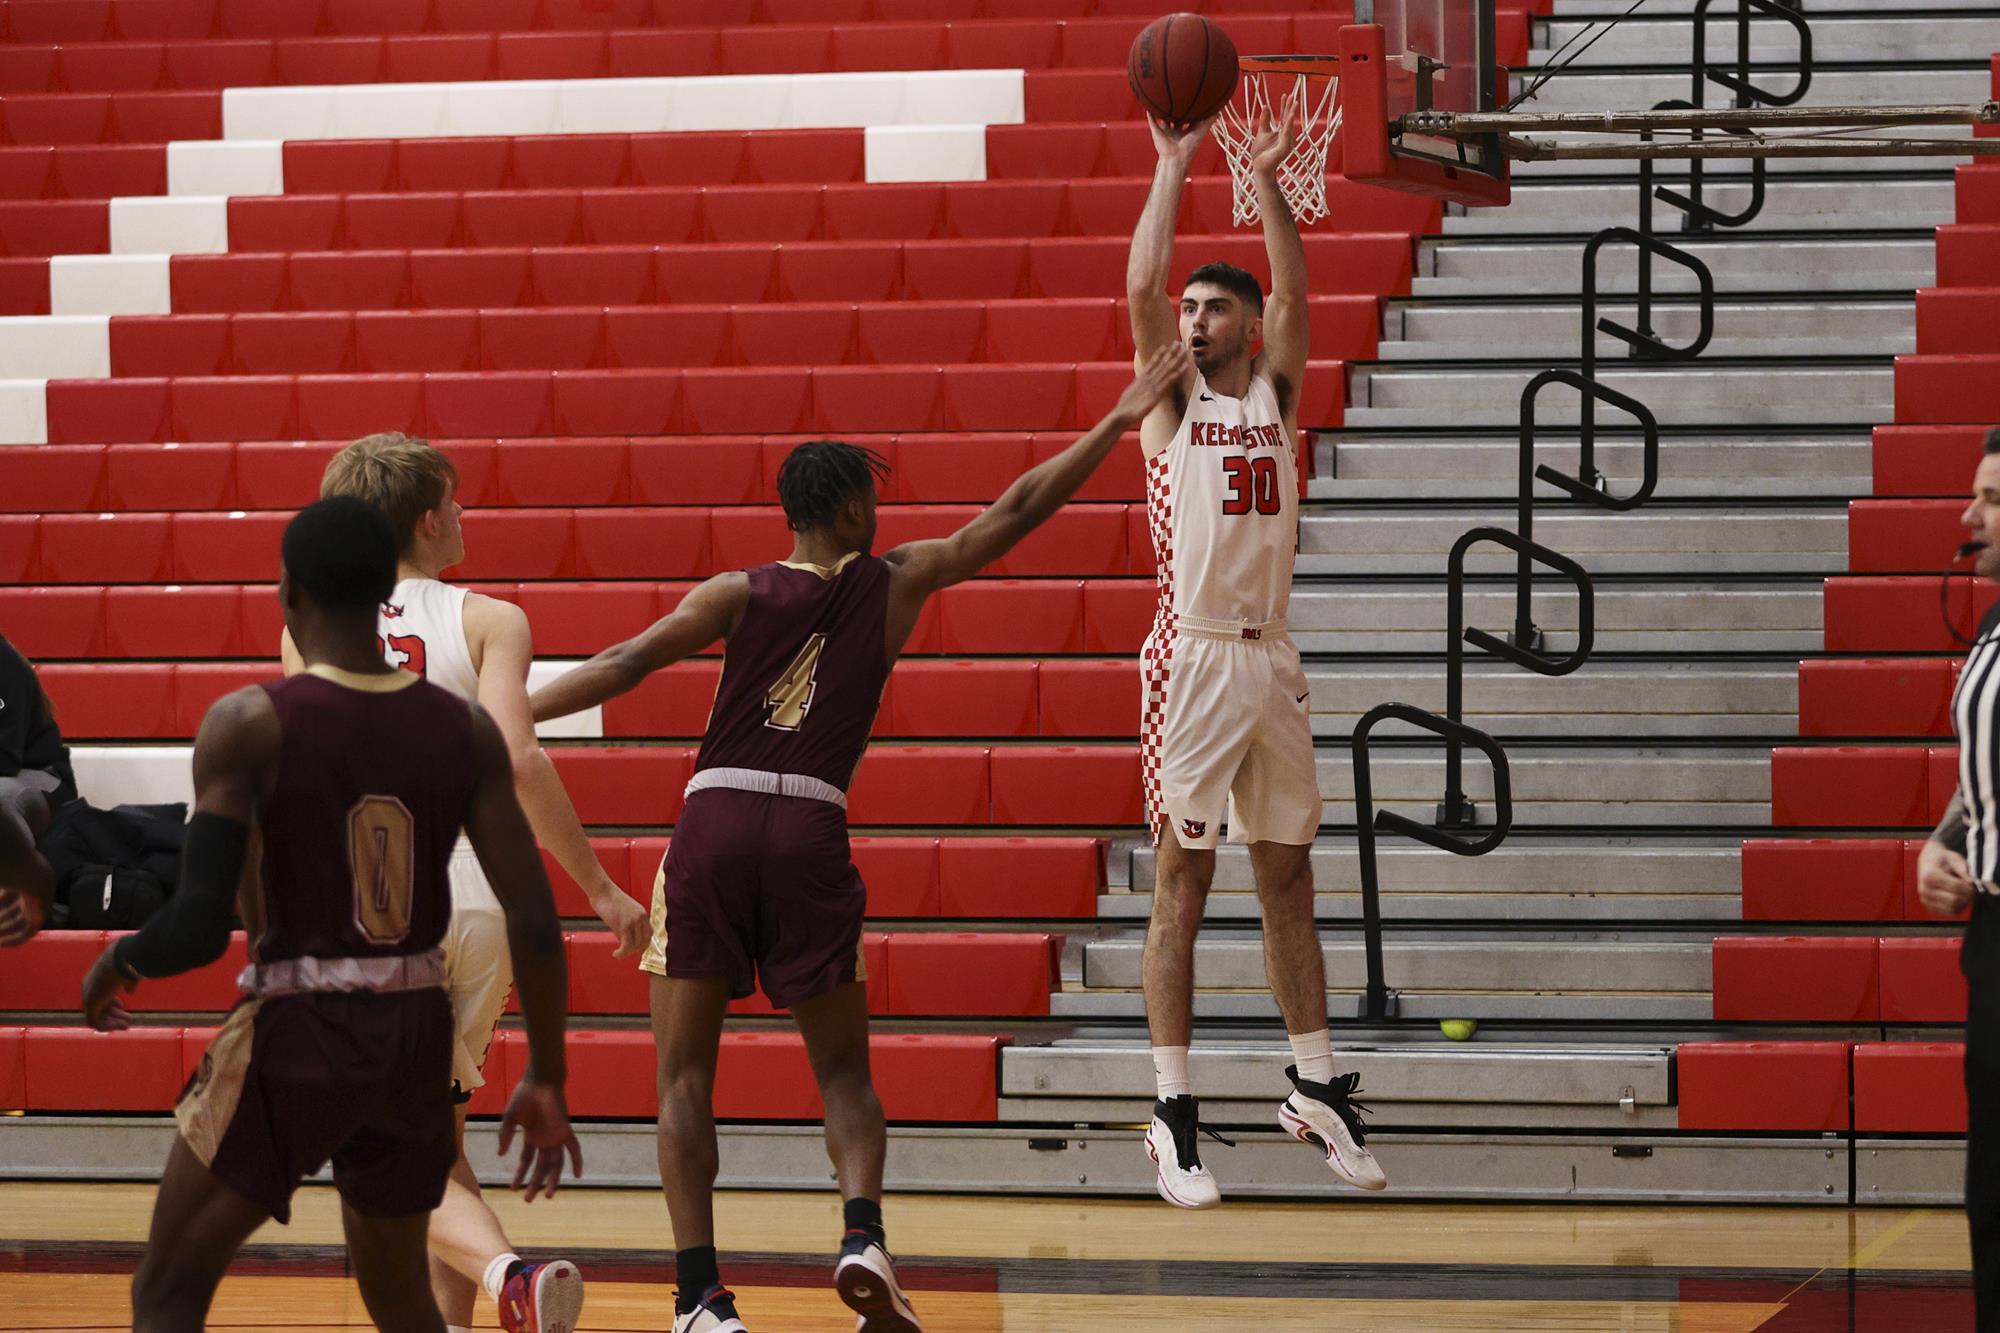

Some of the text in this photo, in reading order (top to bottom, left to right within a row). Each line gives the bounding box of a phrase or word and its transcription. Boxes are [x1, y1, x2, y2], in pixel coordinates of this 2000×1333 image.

[1190, 421, 1243, 446] KEEN
[1222, 455, 1281, 516] 30
[763, 632, 827, 732] 4
[347, 794, 415, 945] 0
